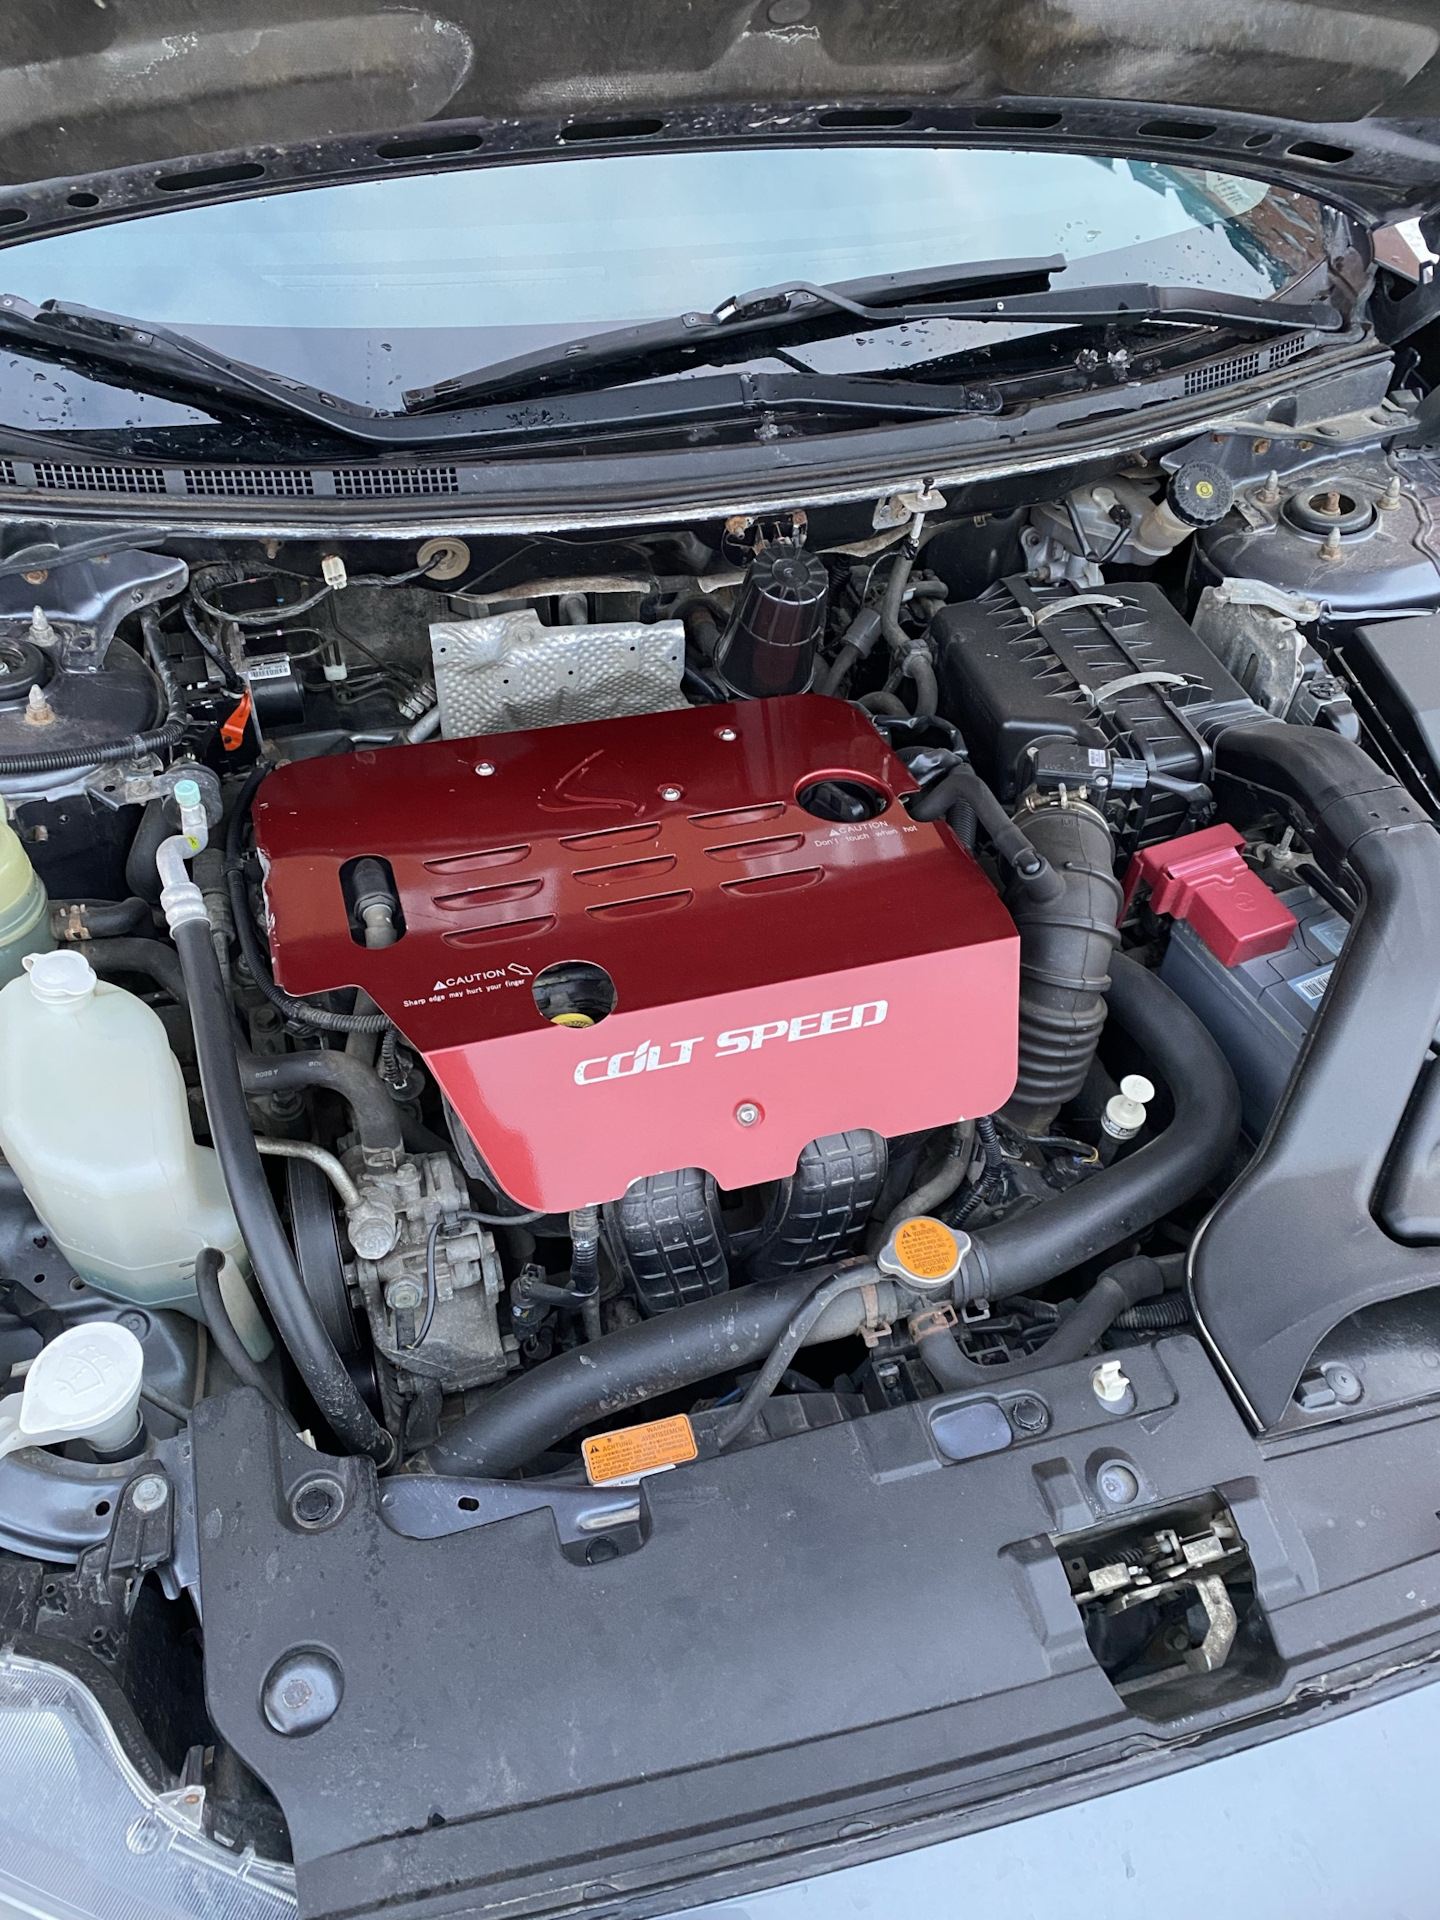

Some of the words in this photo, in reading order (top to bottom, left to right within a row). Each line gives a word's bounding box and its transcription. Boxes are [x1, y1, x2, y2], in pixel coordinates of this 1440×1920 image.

[814, 838, 840, 847] Don't
[845, 832, 870, 842] touch
[875, 828, 898, 837] when
[902, 825, 918, 833] hot
[838, 821, 889, 835] CAUTION
[445, 968, 506, 987] CAUTION
[403, 998, 426, 1008] Sharp
[428, 994, 446, 1003] edge
[449, 990, 464, 999] may
[466, 986, 483, 996] hurt
[485, 983, 502, 993] your
[504, 978, 526, 988] finger
[573, 1036, 705, 1086] COLT
[714, 999, 889, 1058] SPEED
[646, 1421, 677, 1433] WARNING
[602, 1439, 633, 1452] ACHTUNG
